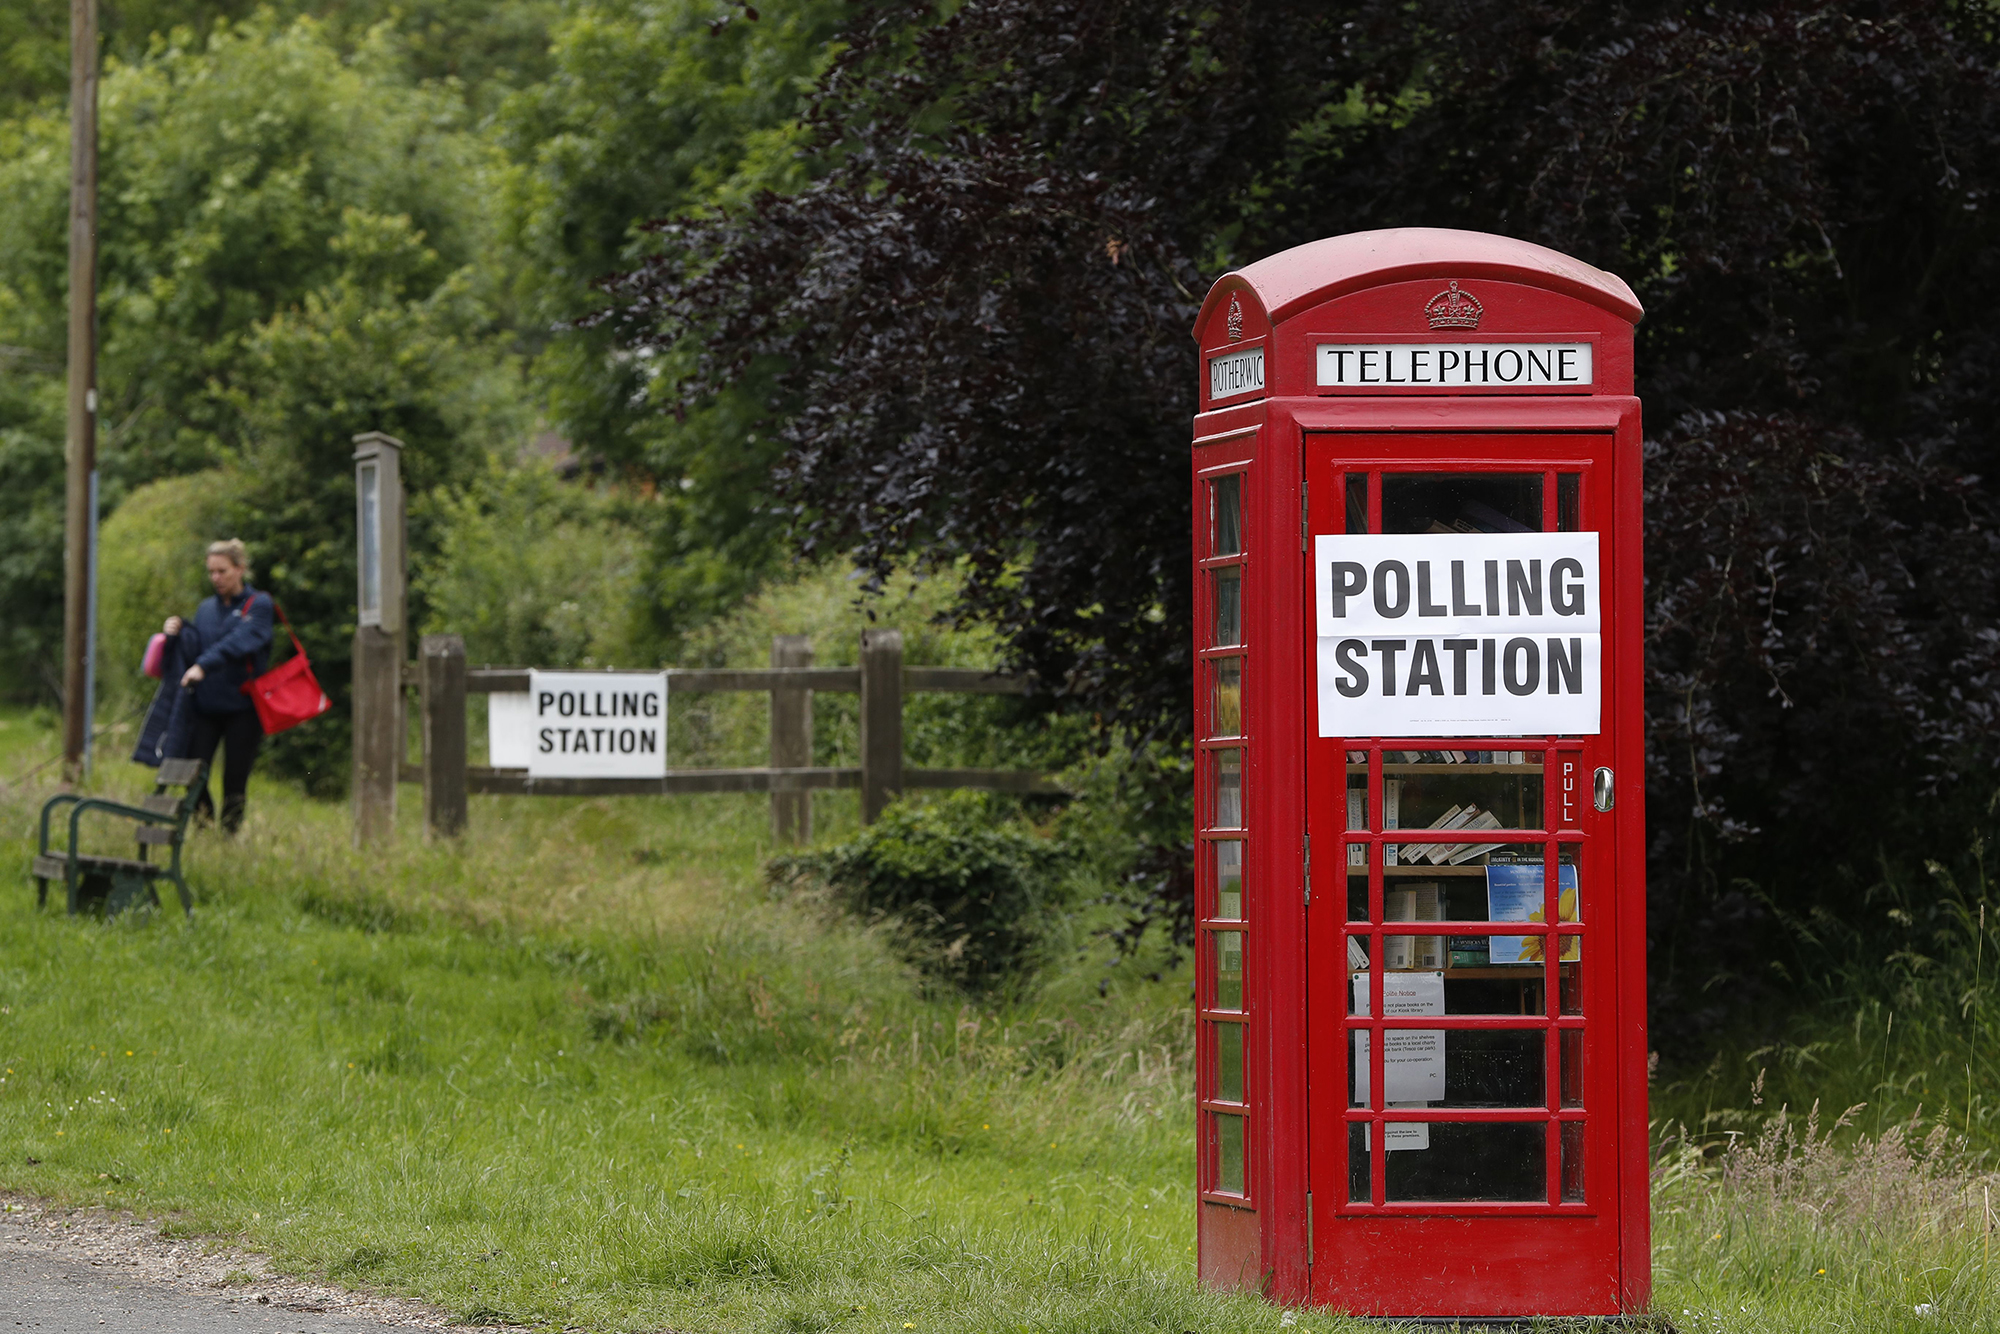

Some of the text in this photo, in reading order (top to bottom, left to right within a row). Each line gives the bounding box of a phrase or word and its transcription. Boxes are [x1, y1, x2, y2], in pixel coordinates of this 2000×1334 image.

[1213, 355, 1263, 392] ROTHERWIC
[1327, 349, 1579, 383] TELEPHONE
[1331, 557, 1585, 619] POLLING
[1335, 637, 1582, 698] STATION
[539, 691, 658, 716] POLLING
[540, 728, 655, 753] STATION
[1563, 762, 1573, 821] PULL
